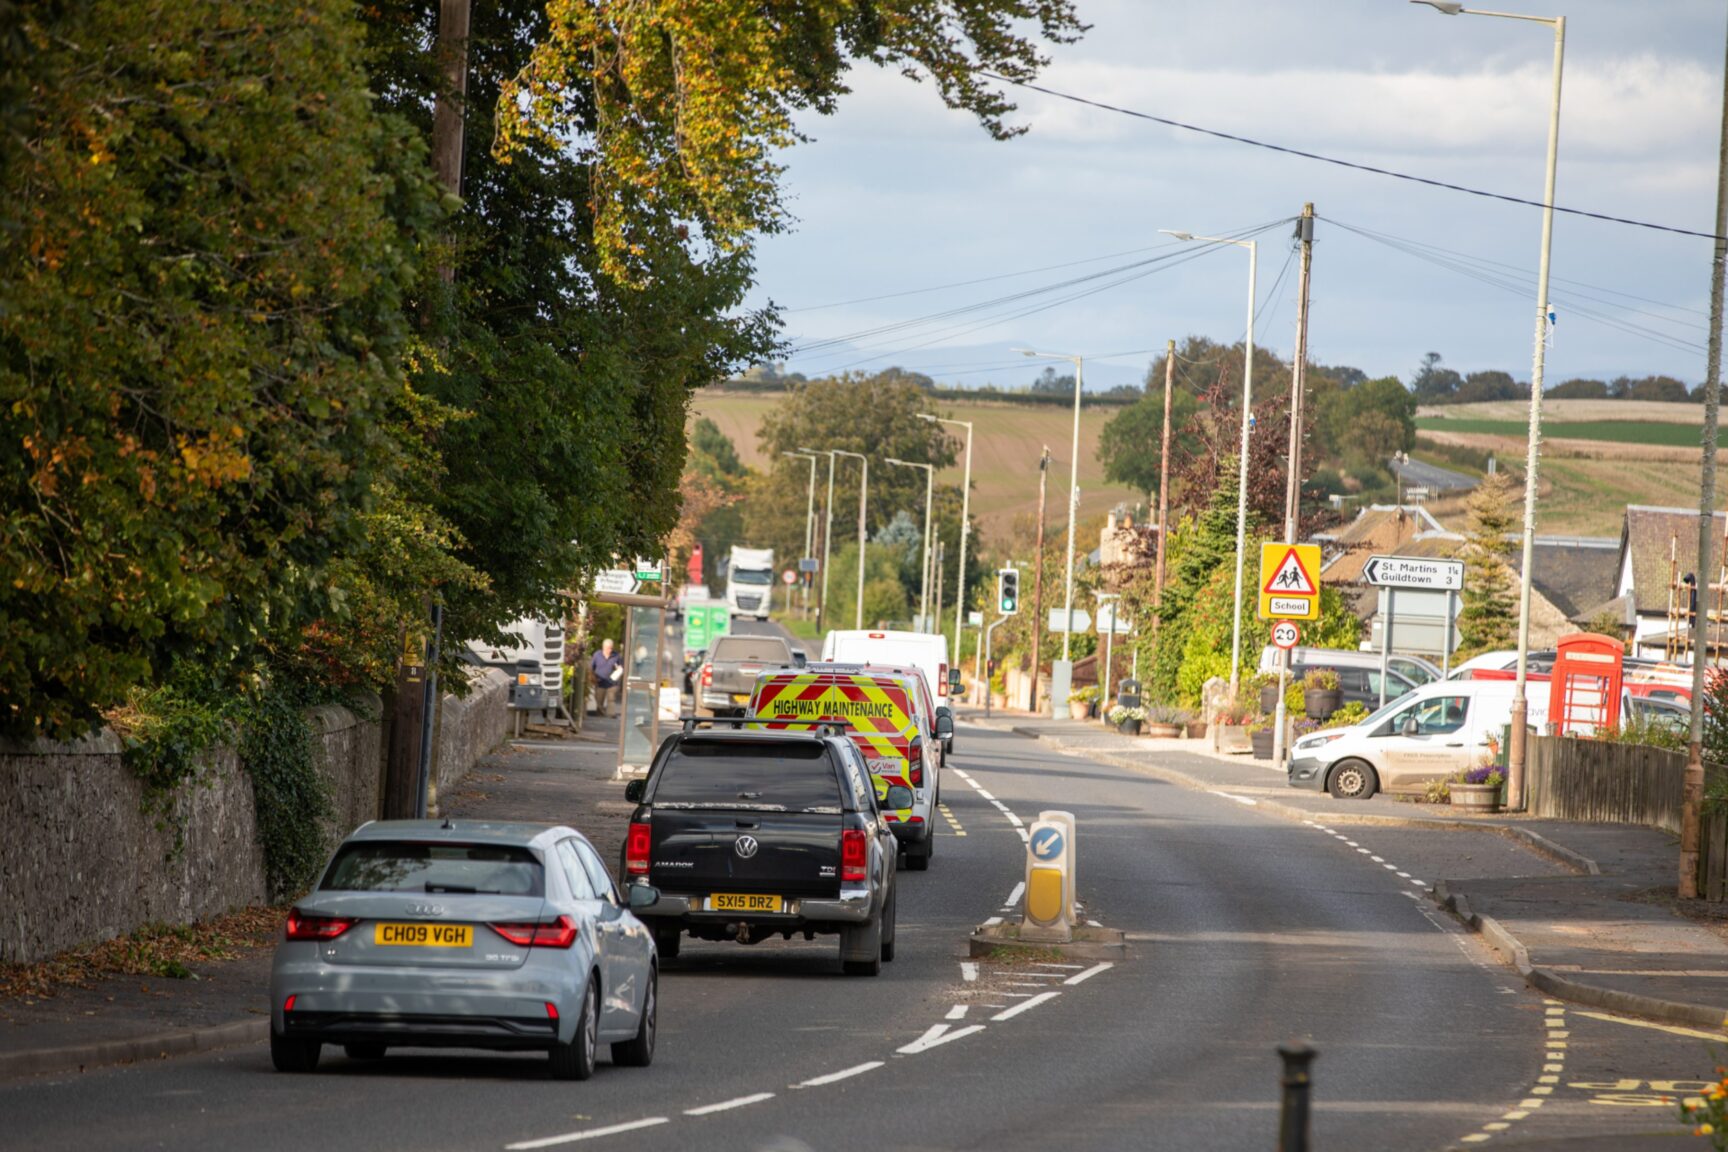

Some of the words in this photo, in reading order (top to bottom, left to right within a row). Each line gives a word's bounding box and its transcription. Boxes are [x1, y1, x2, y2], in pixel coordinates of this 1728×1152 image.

[1400, 563, 1437, 573] Martins
[1381, 572, 1432, 583] Guildtown
[1446, 576, 1453, 585] 3
[1274, 601, 1306, 611] School
[1276, 628, 1296, 641] 20
[773, 700, 821, 715] HIGHWAY
[823, 701, 893, 718] MAINTENANCE
[882, 762, 896, 770] Van
[717, 895, 746, 908] SX15
[749, 896, 774, 909] DRZ
[383, 925, 428, 942] CH09
[433, 927, 466, 943] VGH
